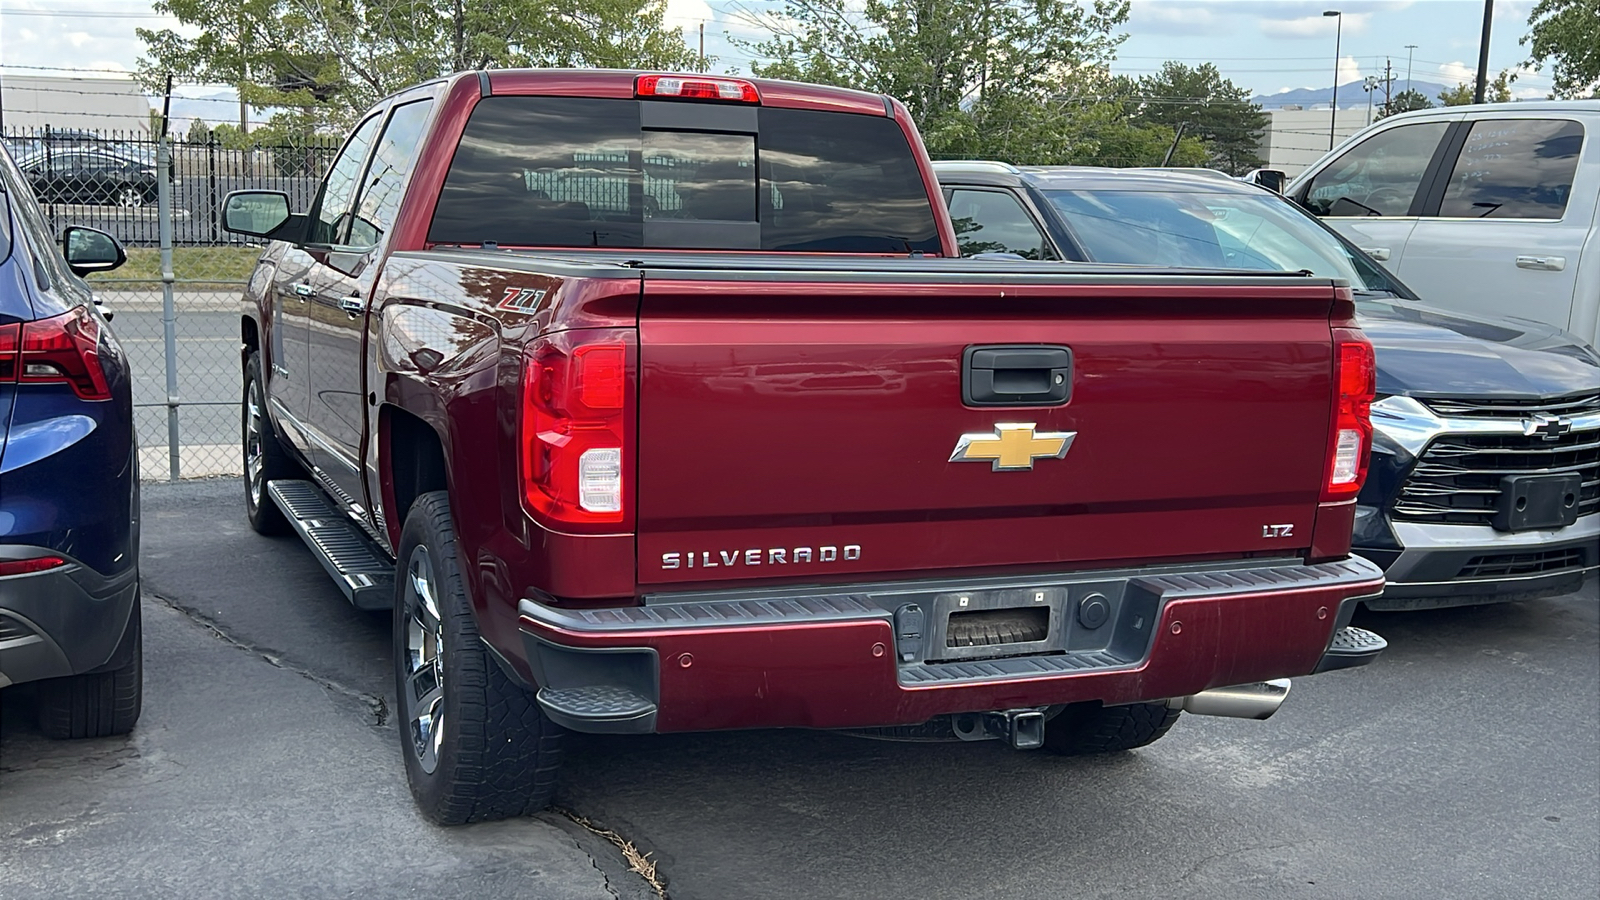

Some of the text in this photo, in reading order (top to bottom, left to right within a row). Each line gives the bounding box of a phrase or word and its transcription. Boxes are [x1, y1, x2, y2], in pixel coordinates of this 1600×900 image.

[496, 286, 546, 314] Z71
[1262, 523, 1294, 538] LTZ
[661, 544, 862, 570] SILVERADO
